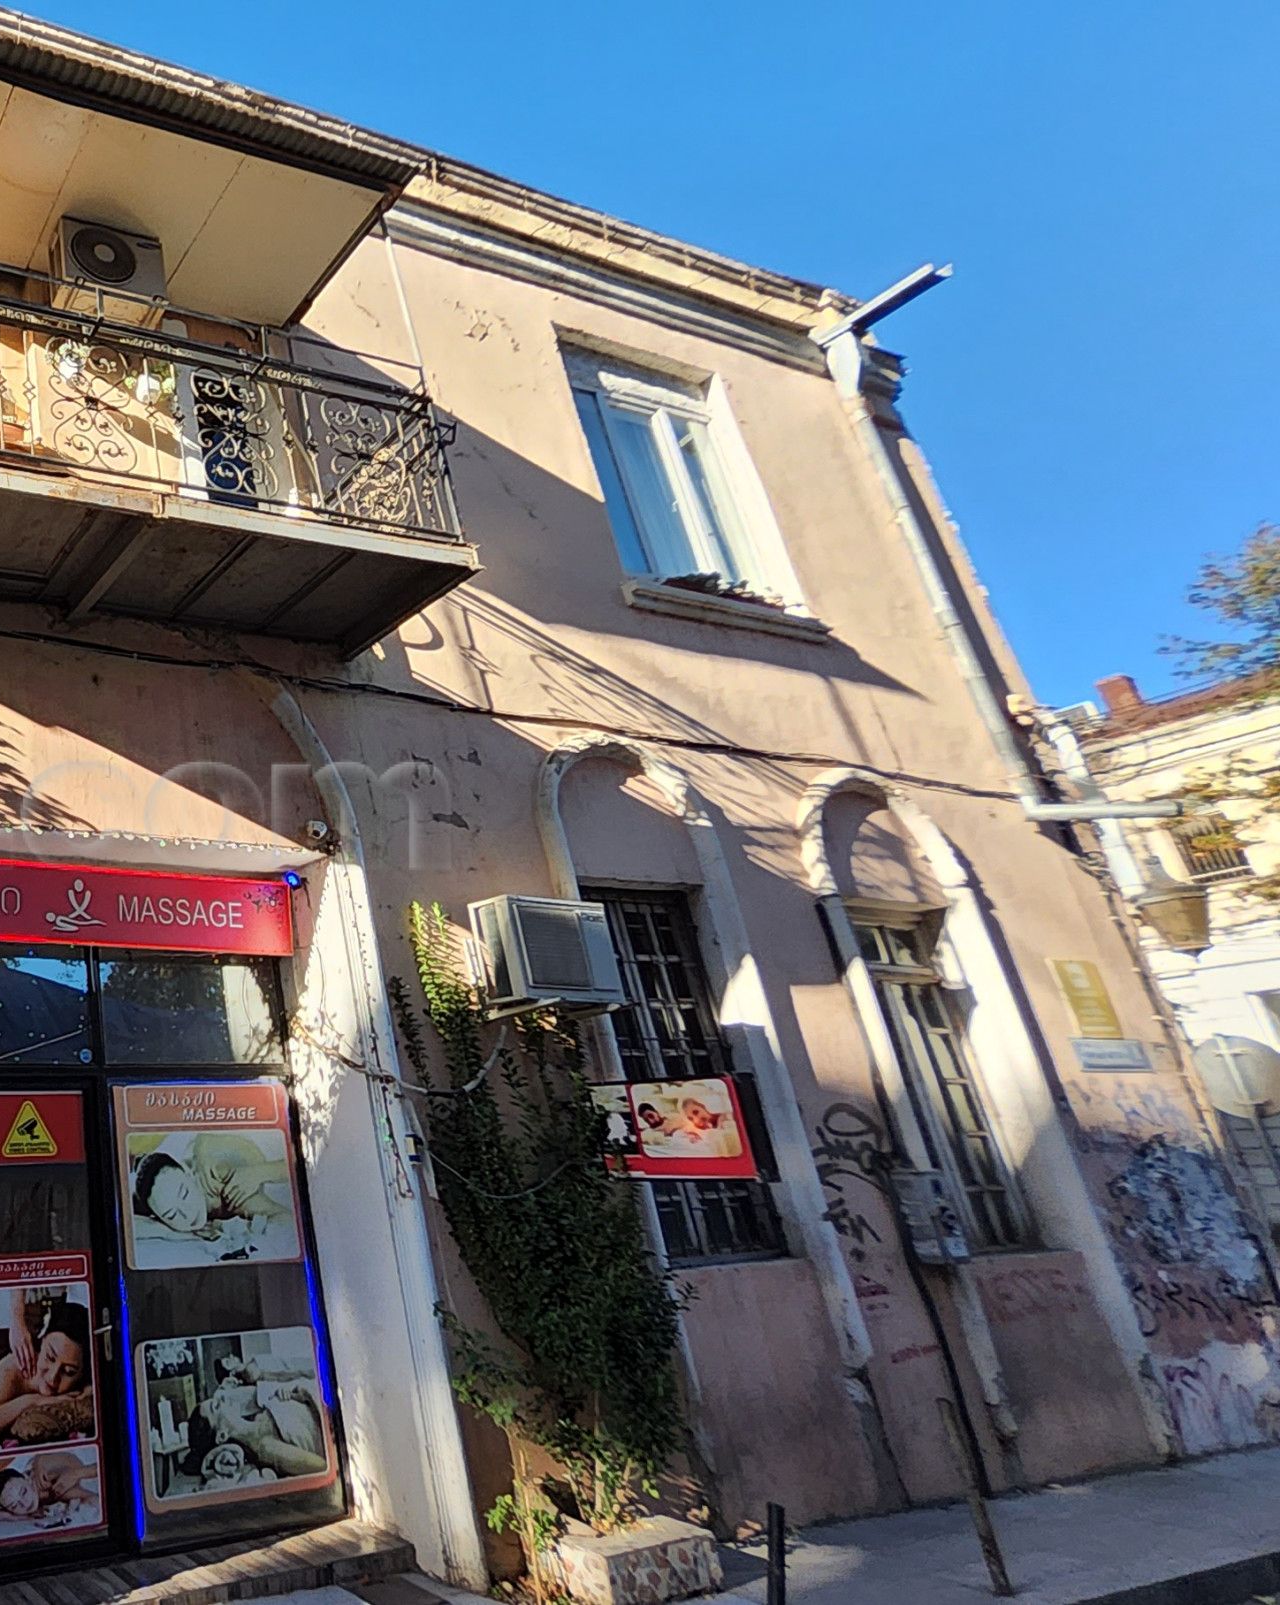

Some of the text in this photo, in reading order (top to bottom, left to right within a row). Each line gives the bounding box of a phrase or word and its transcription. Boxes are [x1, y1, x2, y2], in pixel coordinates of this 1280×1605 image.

[118, 893, 245, 930] MASSAGE
[145, 1091, 216, 1108] მასაჟი
[182, 1106, 257, 1121] MASSAGE
[20, 1268, 73, 1279] MASSAGE
